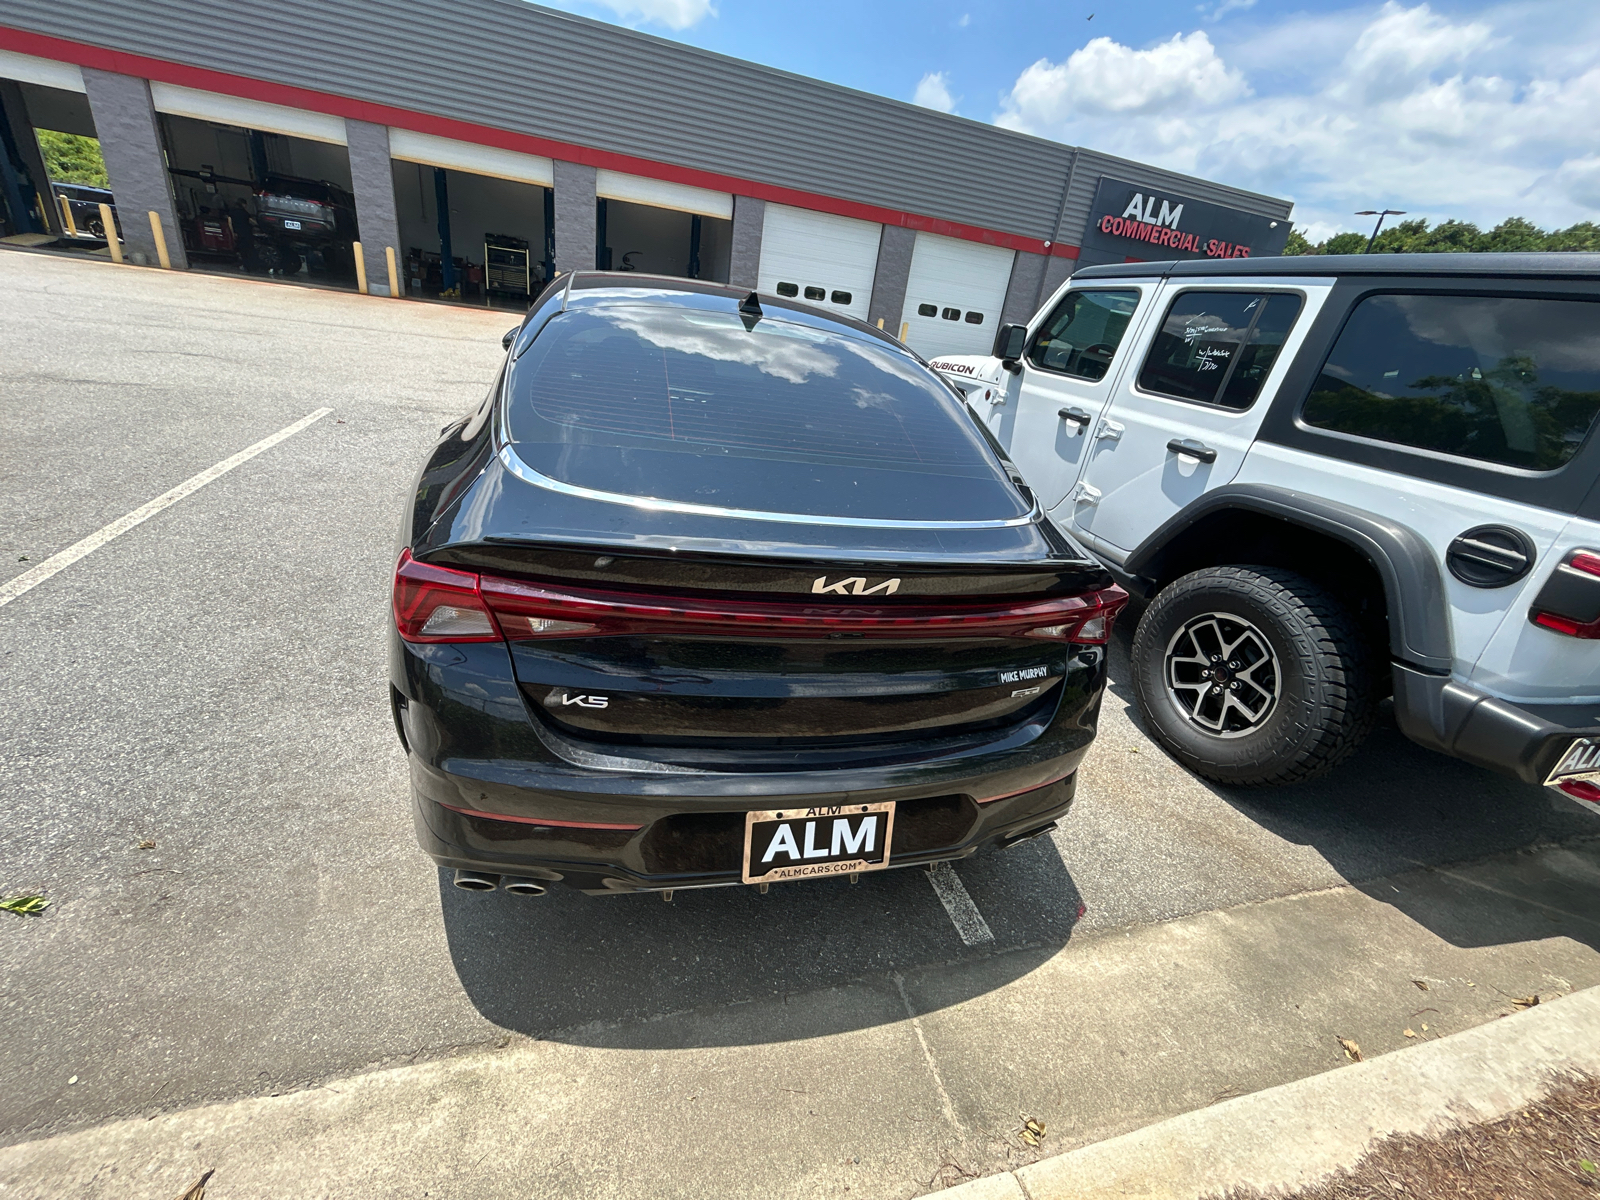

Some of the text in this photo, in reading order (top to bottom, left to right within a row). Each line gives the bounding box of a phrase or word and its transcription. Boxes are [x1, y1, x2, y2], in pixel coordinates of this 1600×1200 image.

[1122, 193, 1184, 229] ALM
[1101, 215, 1250, 259] COMMERCIAL SALES
[930, 361, 975, 375] RUBICON
[811, 576, 901, 595] KIA
[1001, 666, 1047, 683] MIKE MURPHY
[562, 693, 608, 708] K5
[806, 805, 841, 817] ALM
[761, 816, 877, 862] ALM
[779, 862, 857, 878] ALMCARS.COM
